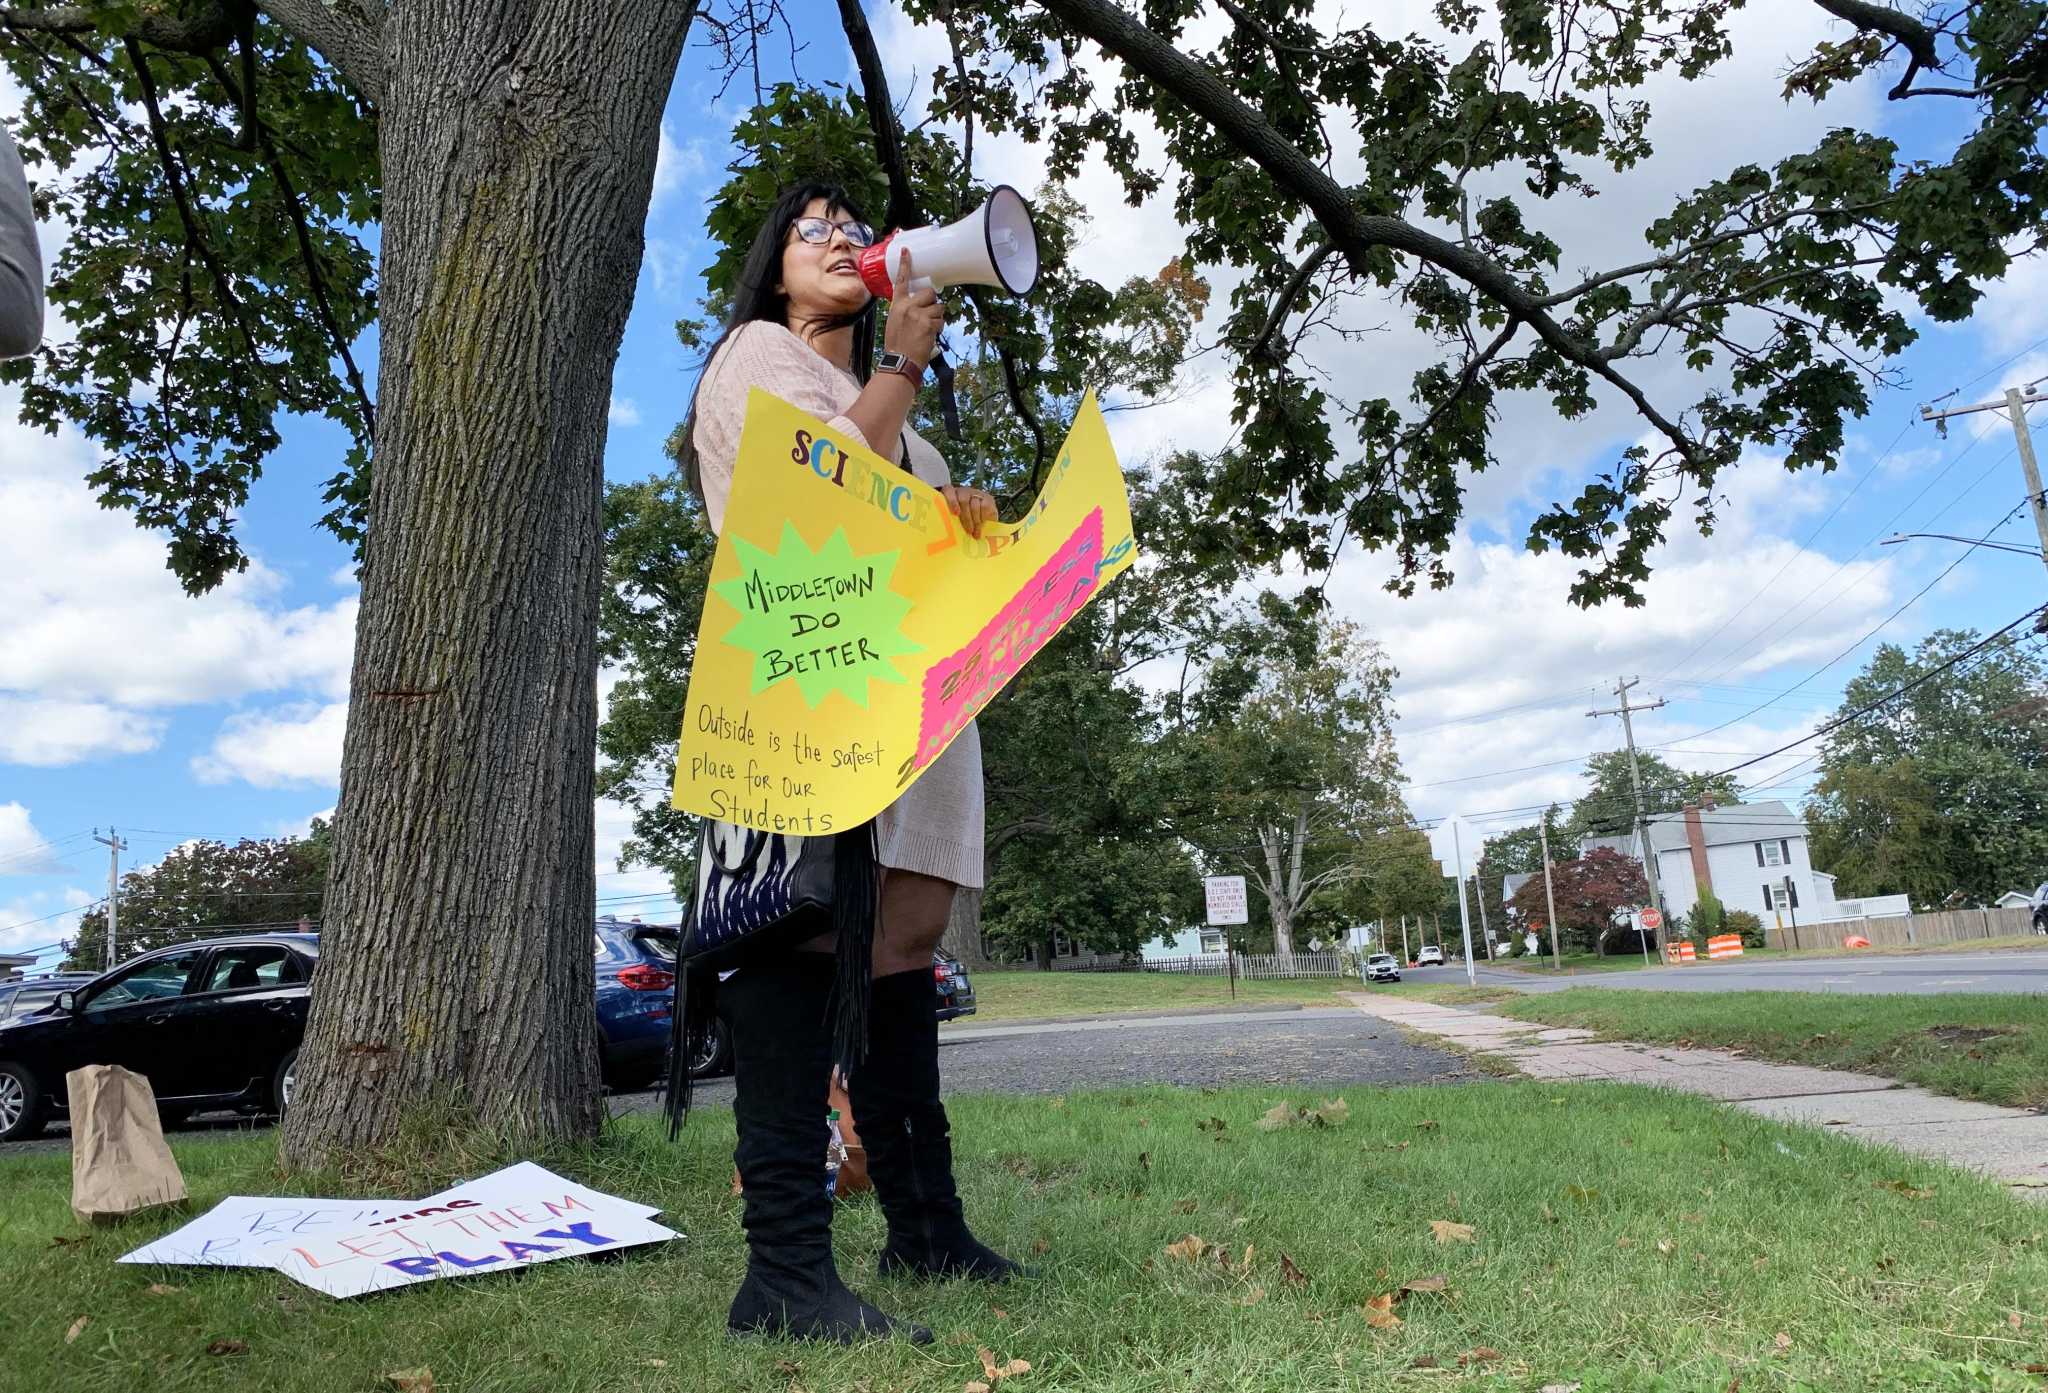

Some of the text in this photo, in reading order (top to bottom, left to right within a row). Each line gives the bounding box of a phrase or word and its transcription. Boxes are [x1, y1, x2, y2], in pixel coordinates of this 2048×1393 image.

[791, 429, 932, 534] SCIENCE
[790, 612, 840, 637] DO
[763, 637, 879, 681] BETTER
[698, 704, 885, 772] Outside is the safest
[692, 752, 736, 781] place
[709, 789, 833, 832] Students
[1642, 912, 1660, 923] STOP
[291, 1225, 425, 1269] LET
[433, 1195, 594, 1238] THEM
[383, 1221, 617, 1276] PLAY
